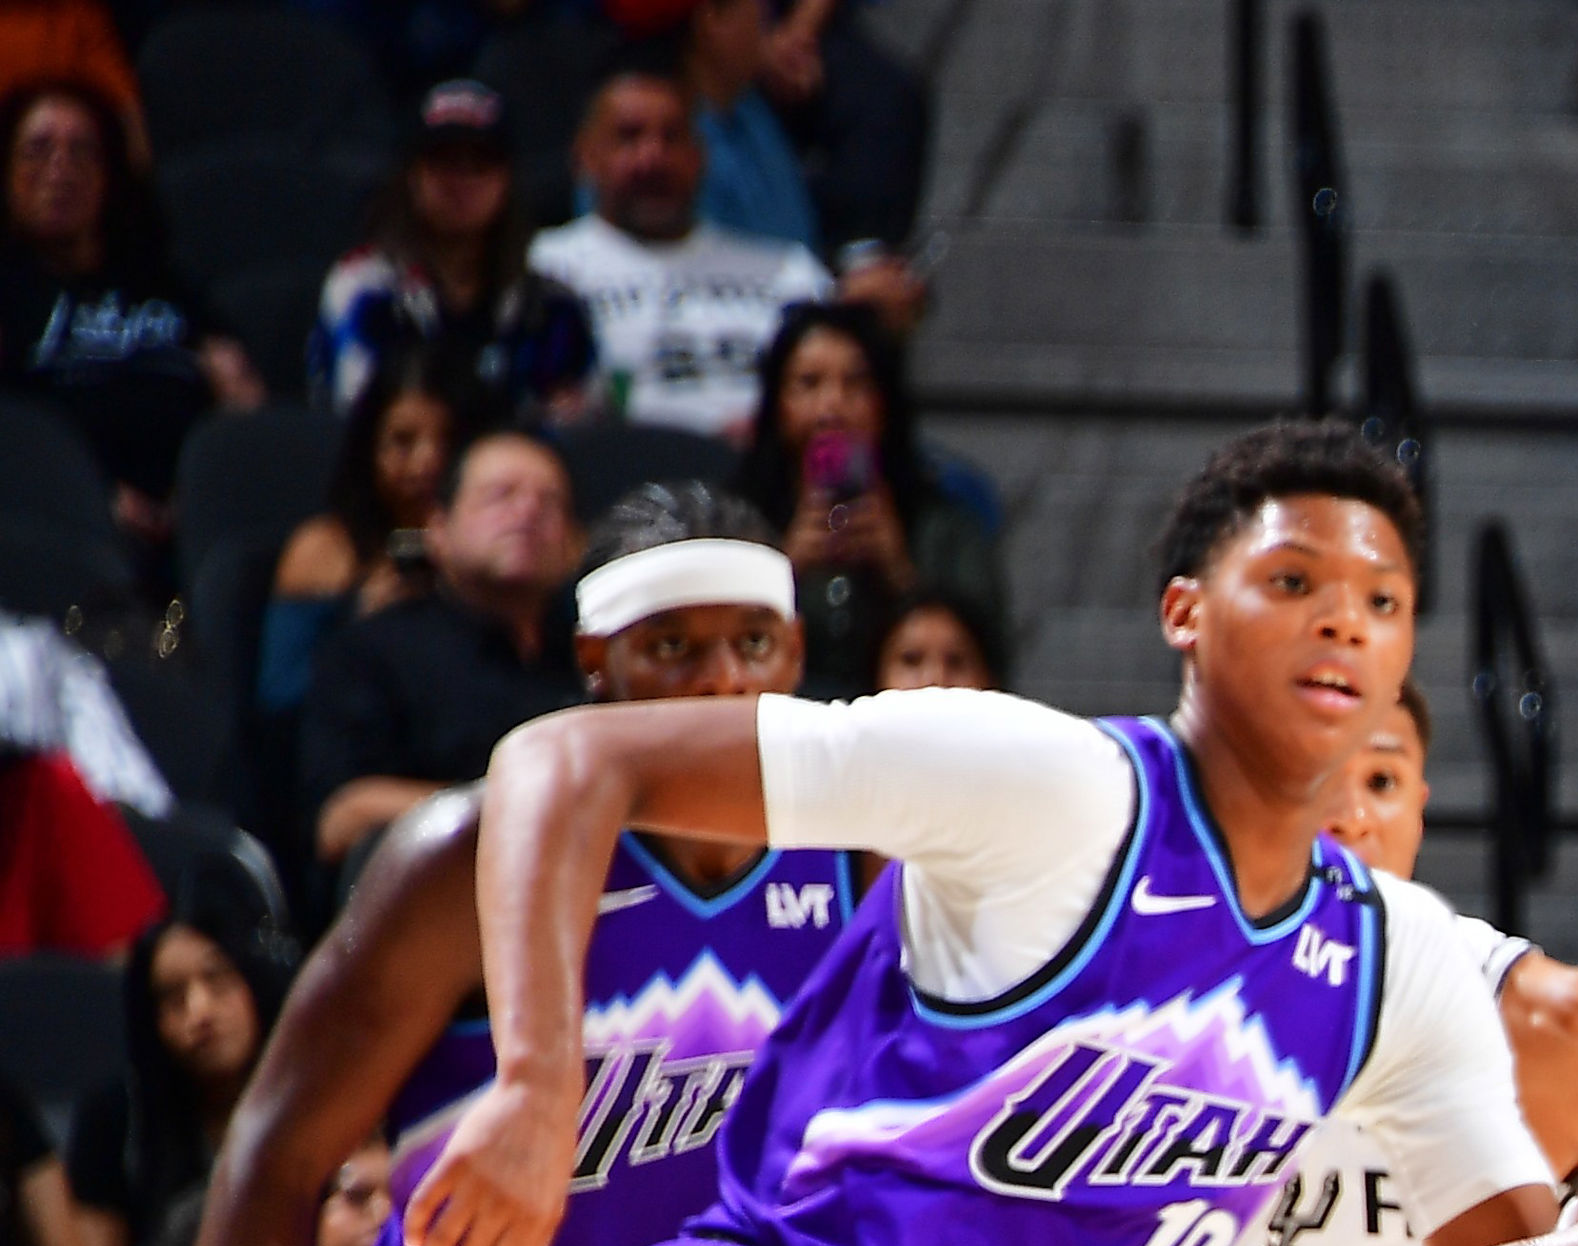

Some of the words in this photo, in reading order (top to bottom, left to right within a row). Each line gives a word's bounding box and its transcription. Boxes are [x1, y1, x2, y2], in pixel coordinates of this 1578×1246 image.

[765, 882, 835, 930] LVT
[1292, 923, 1355, 987] LVT
[968, 1039, 1316, 1203] UTAH
